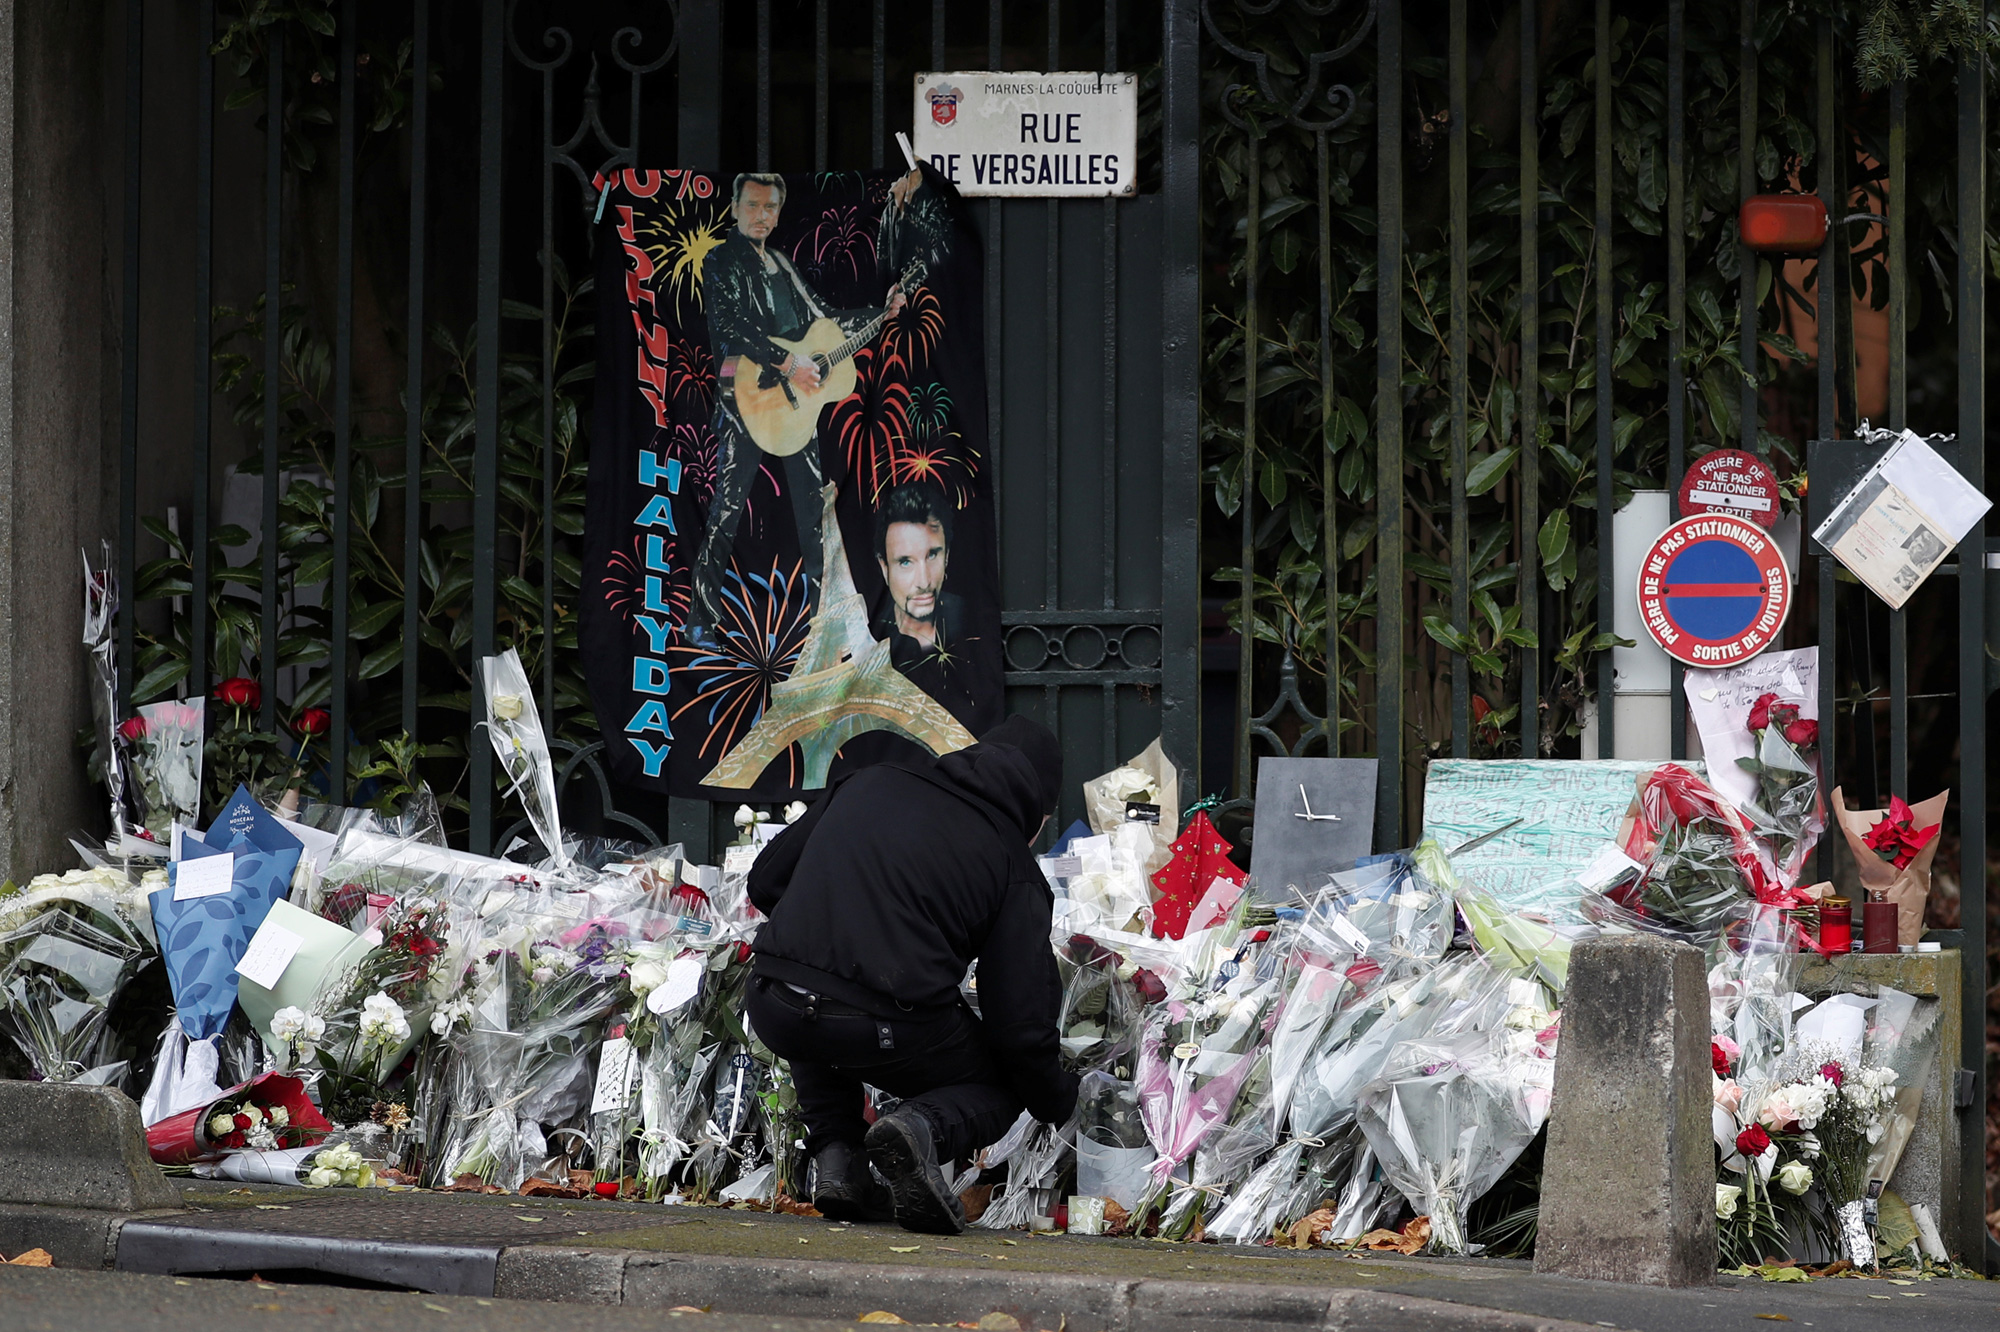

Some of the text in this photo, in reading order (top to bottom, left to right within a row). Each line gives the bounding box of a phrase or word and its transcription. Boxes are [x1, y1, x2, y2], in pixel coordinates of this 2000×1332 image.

[1021, 113, 1081, 143] RUE
[931, 154, 1119, 185] DE VERSAILLES
[1700, 457, 1765, 482] PRIERE DE
[1713, 471, 1752, 485] NE PAS
[1696, 480, 1767, 497] STATIONNER
[1706, 505, 1753, 520] SORTIE
[1644, 521, 1765, 646] PRIÈRE DE NE PAS STATIONNER
[623, 449, 683, 778] HALLYDAY
[1692, 567, 1783, 661] SORTIE DE VOITURES
[1537, 768, 1597, 791] SANS
[229, 816, 255, 824] MONCEAU
